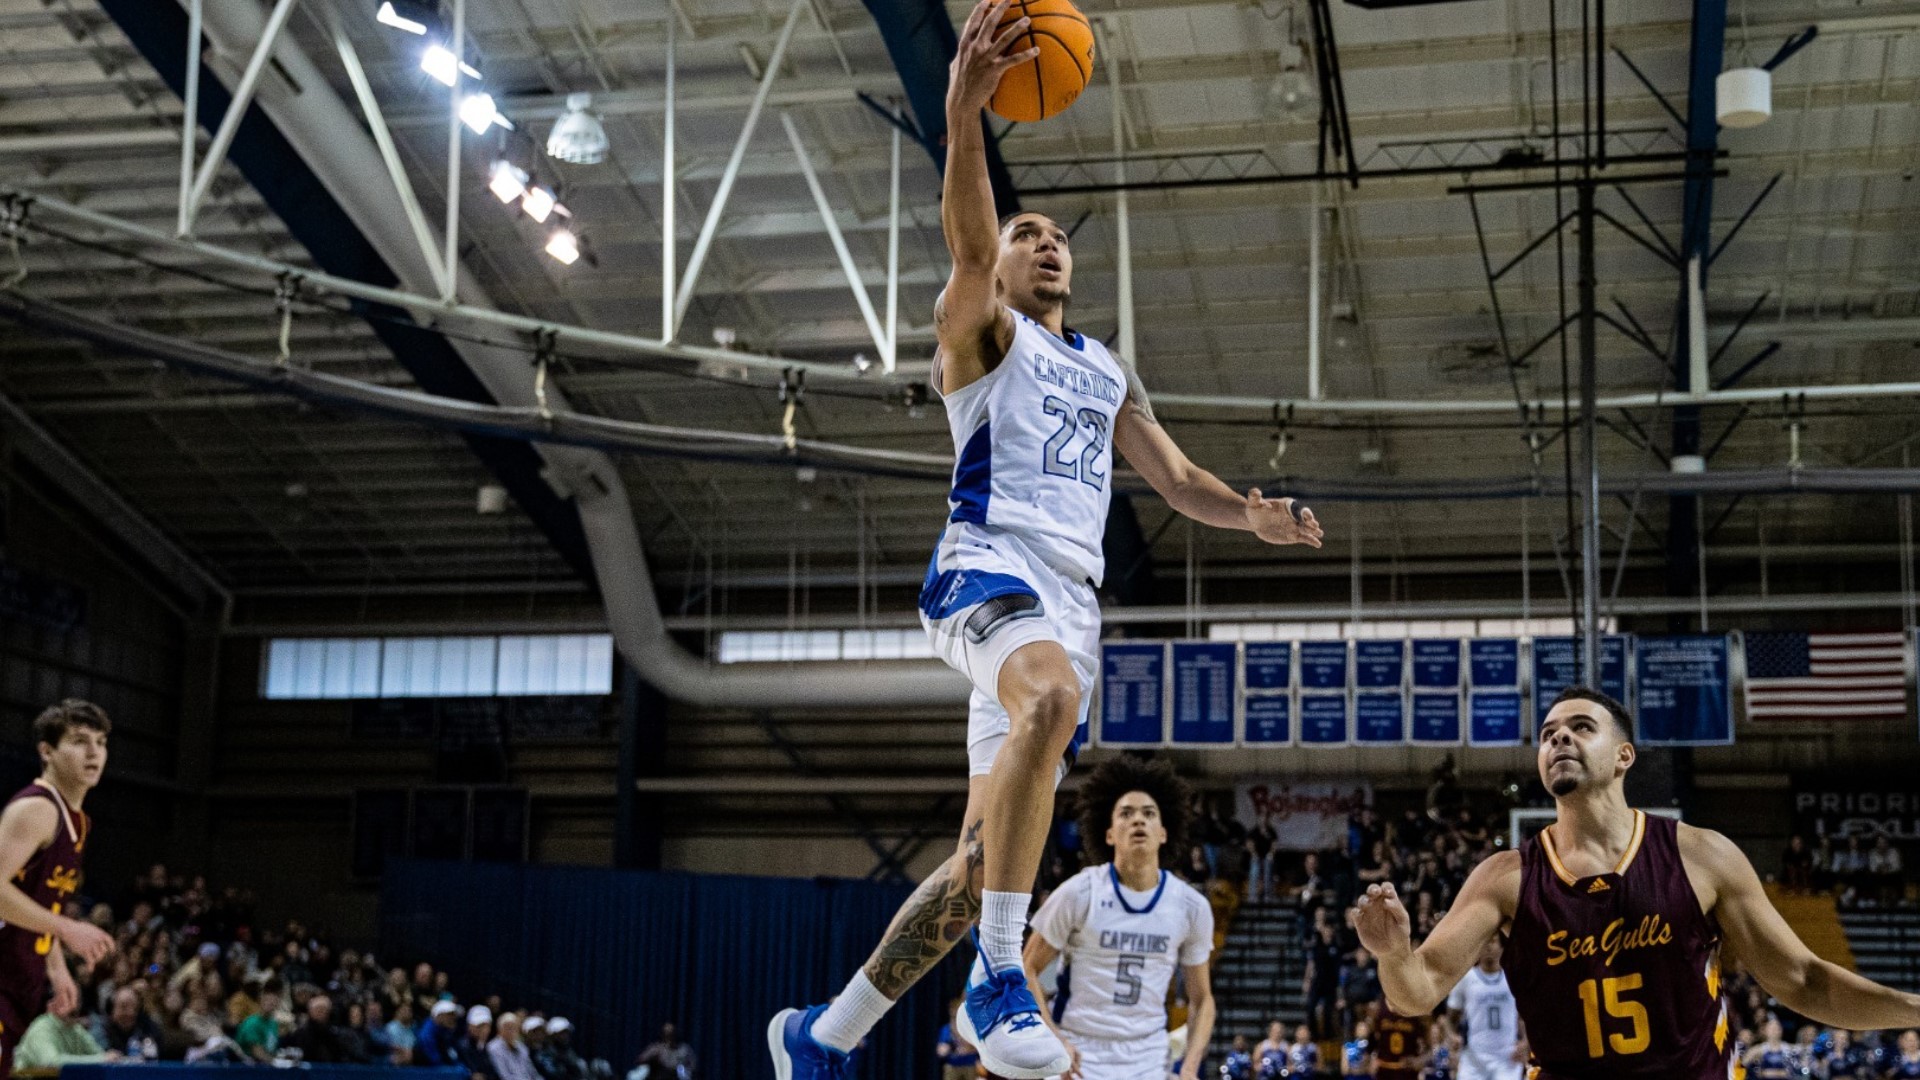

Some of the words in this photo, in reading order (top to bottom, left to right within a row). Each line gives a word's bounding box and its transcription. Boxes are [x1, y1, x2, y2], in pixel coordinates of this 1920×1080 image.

[1034, 354, 1120, 406] CAPTAINS
[1042, 395, 1107, 492] 22
[1100, 930, 1170, 953] CAPTAINS
[1547, 930, 1598, 965] Sea
[1601, 913, 1672, 966] Gulls
[1113, 954, 1145, 1005] 5
[1578, 973, 1651, 1058] 15
